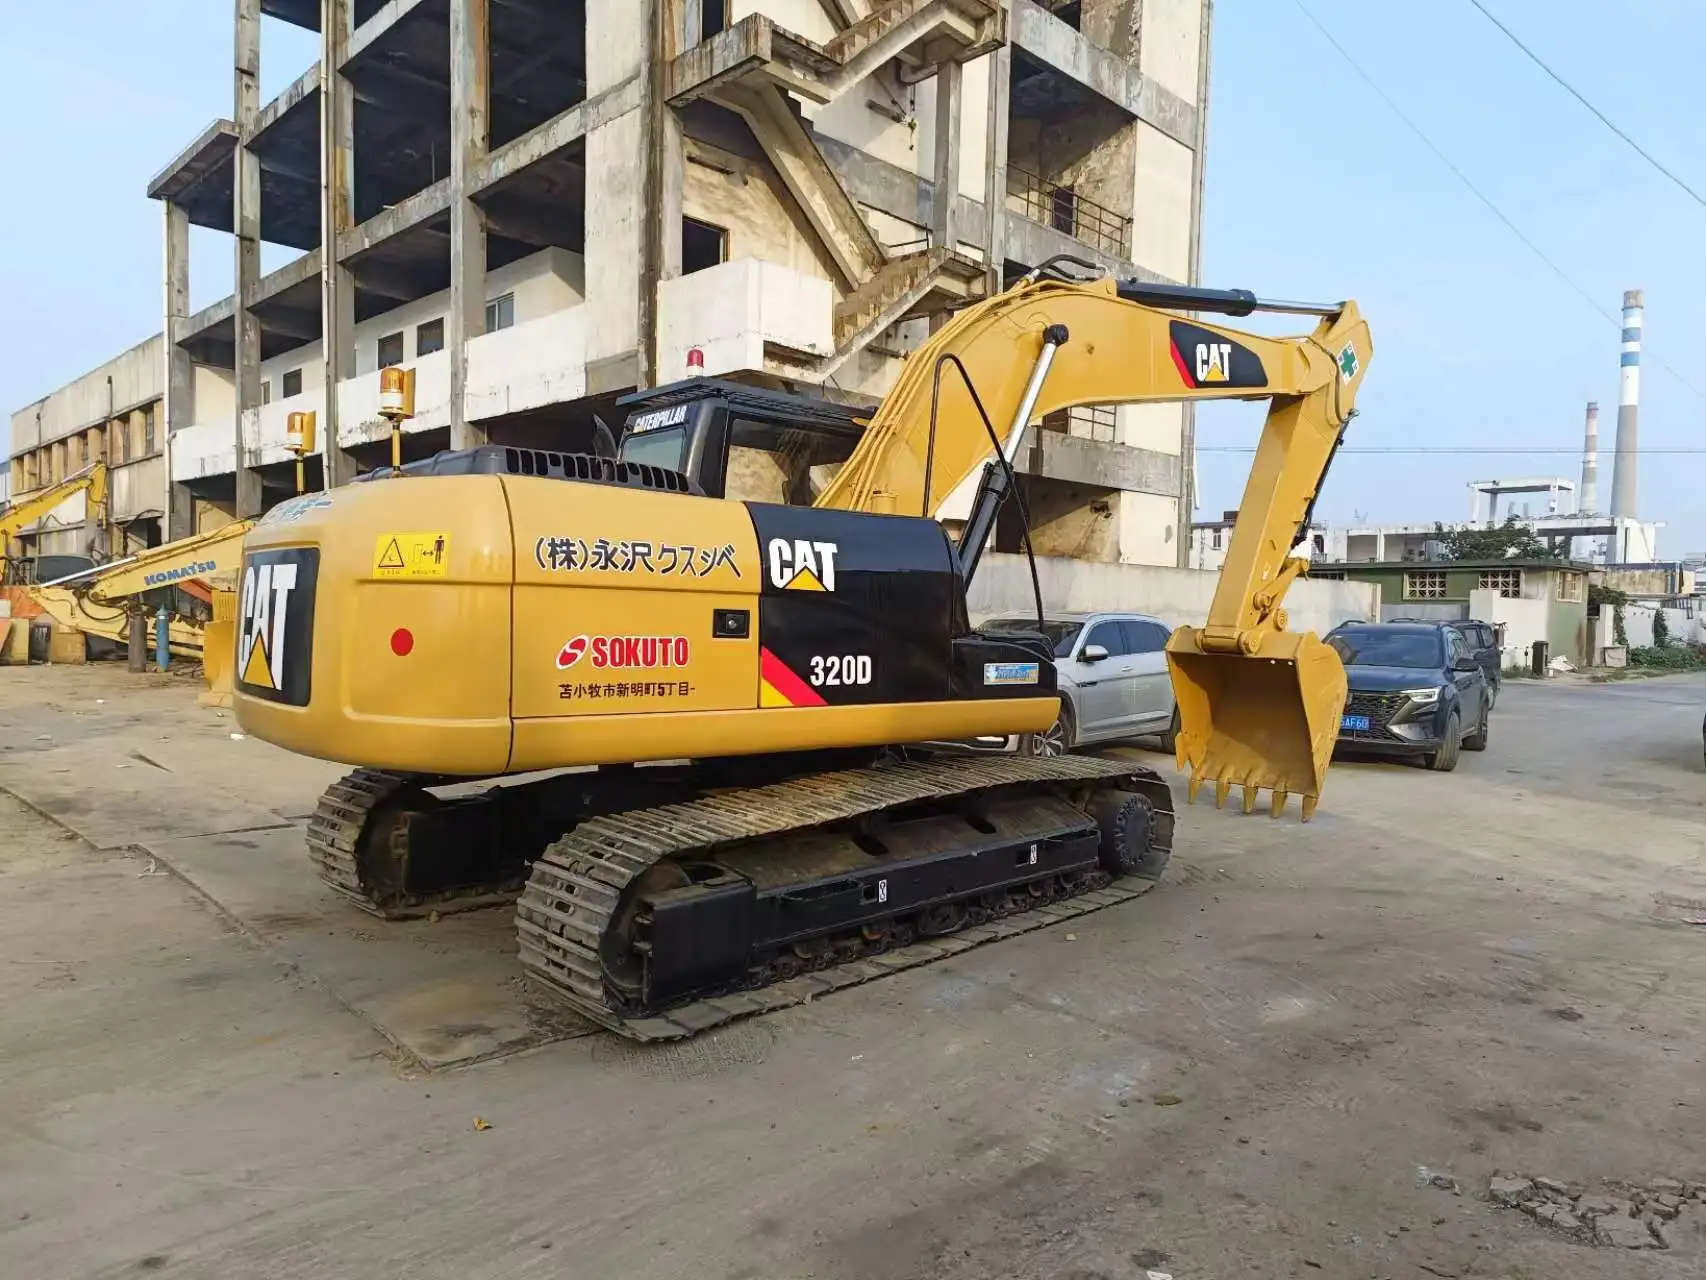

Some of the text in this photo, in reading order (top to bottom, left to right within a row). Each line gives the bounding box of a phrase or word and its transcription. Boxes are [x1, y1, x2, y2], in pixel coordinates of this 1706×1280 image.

[1195, 343, 1232, 382] CAT
[633, 404, 687, 432] CATERPILLAR
[144, 560, 217, 586] KOMATSU
[768, 538, 838, 592] CAT
[237, 563, 298, 691] CAT
[592, 636, 690, 668] SOKUTO
[809, 655, 873, 687] 320D
